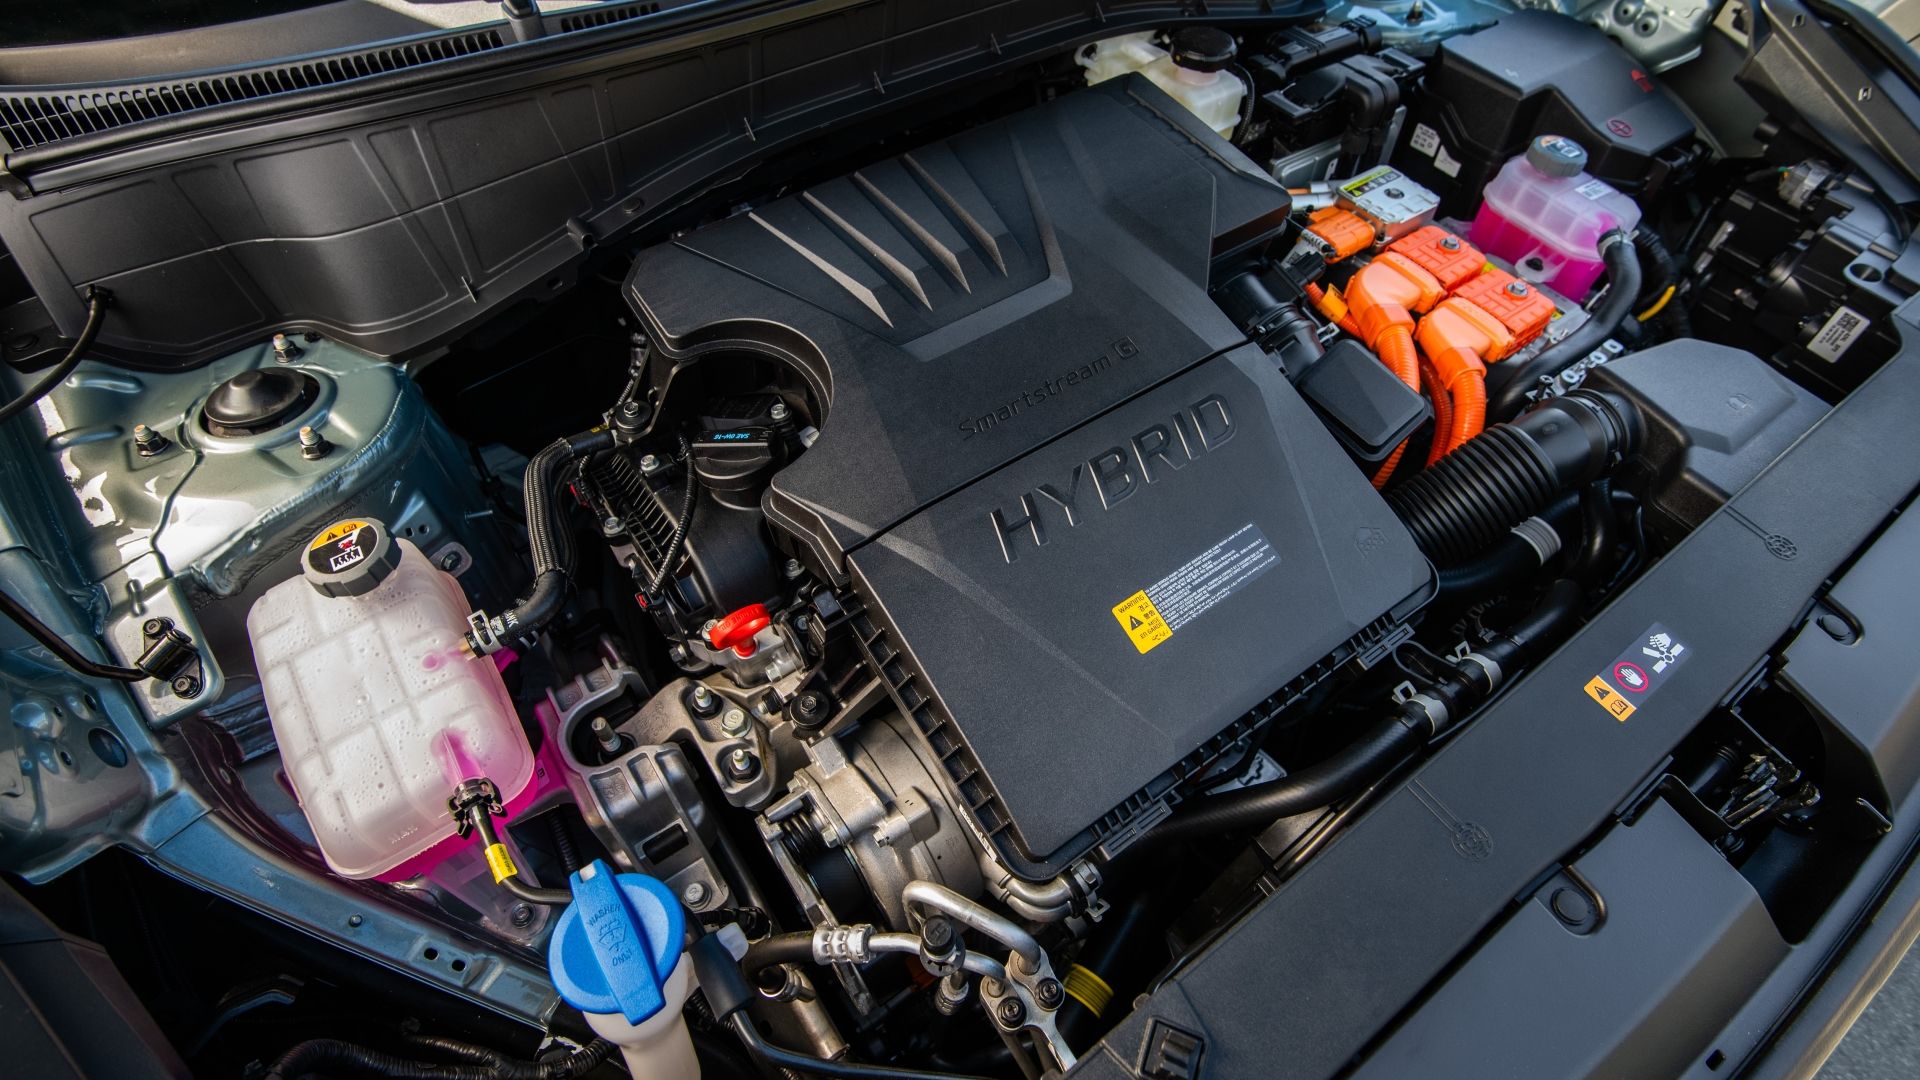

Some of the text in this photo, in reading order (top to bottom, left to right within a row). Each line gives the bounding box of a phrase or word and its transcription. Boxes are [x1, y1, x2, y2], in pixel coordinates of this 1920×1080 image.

[958, 335, 1140, 441] Smartstream G
[990, 393, 1238, 564] HYBRID
[1118, 595, 1145, 613] WARNING
[586, 903, 621, 927] WASHER
[612, 948, 633, 967] ONLY
